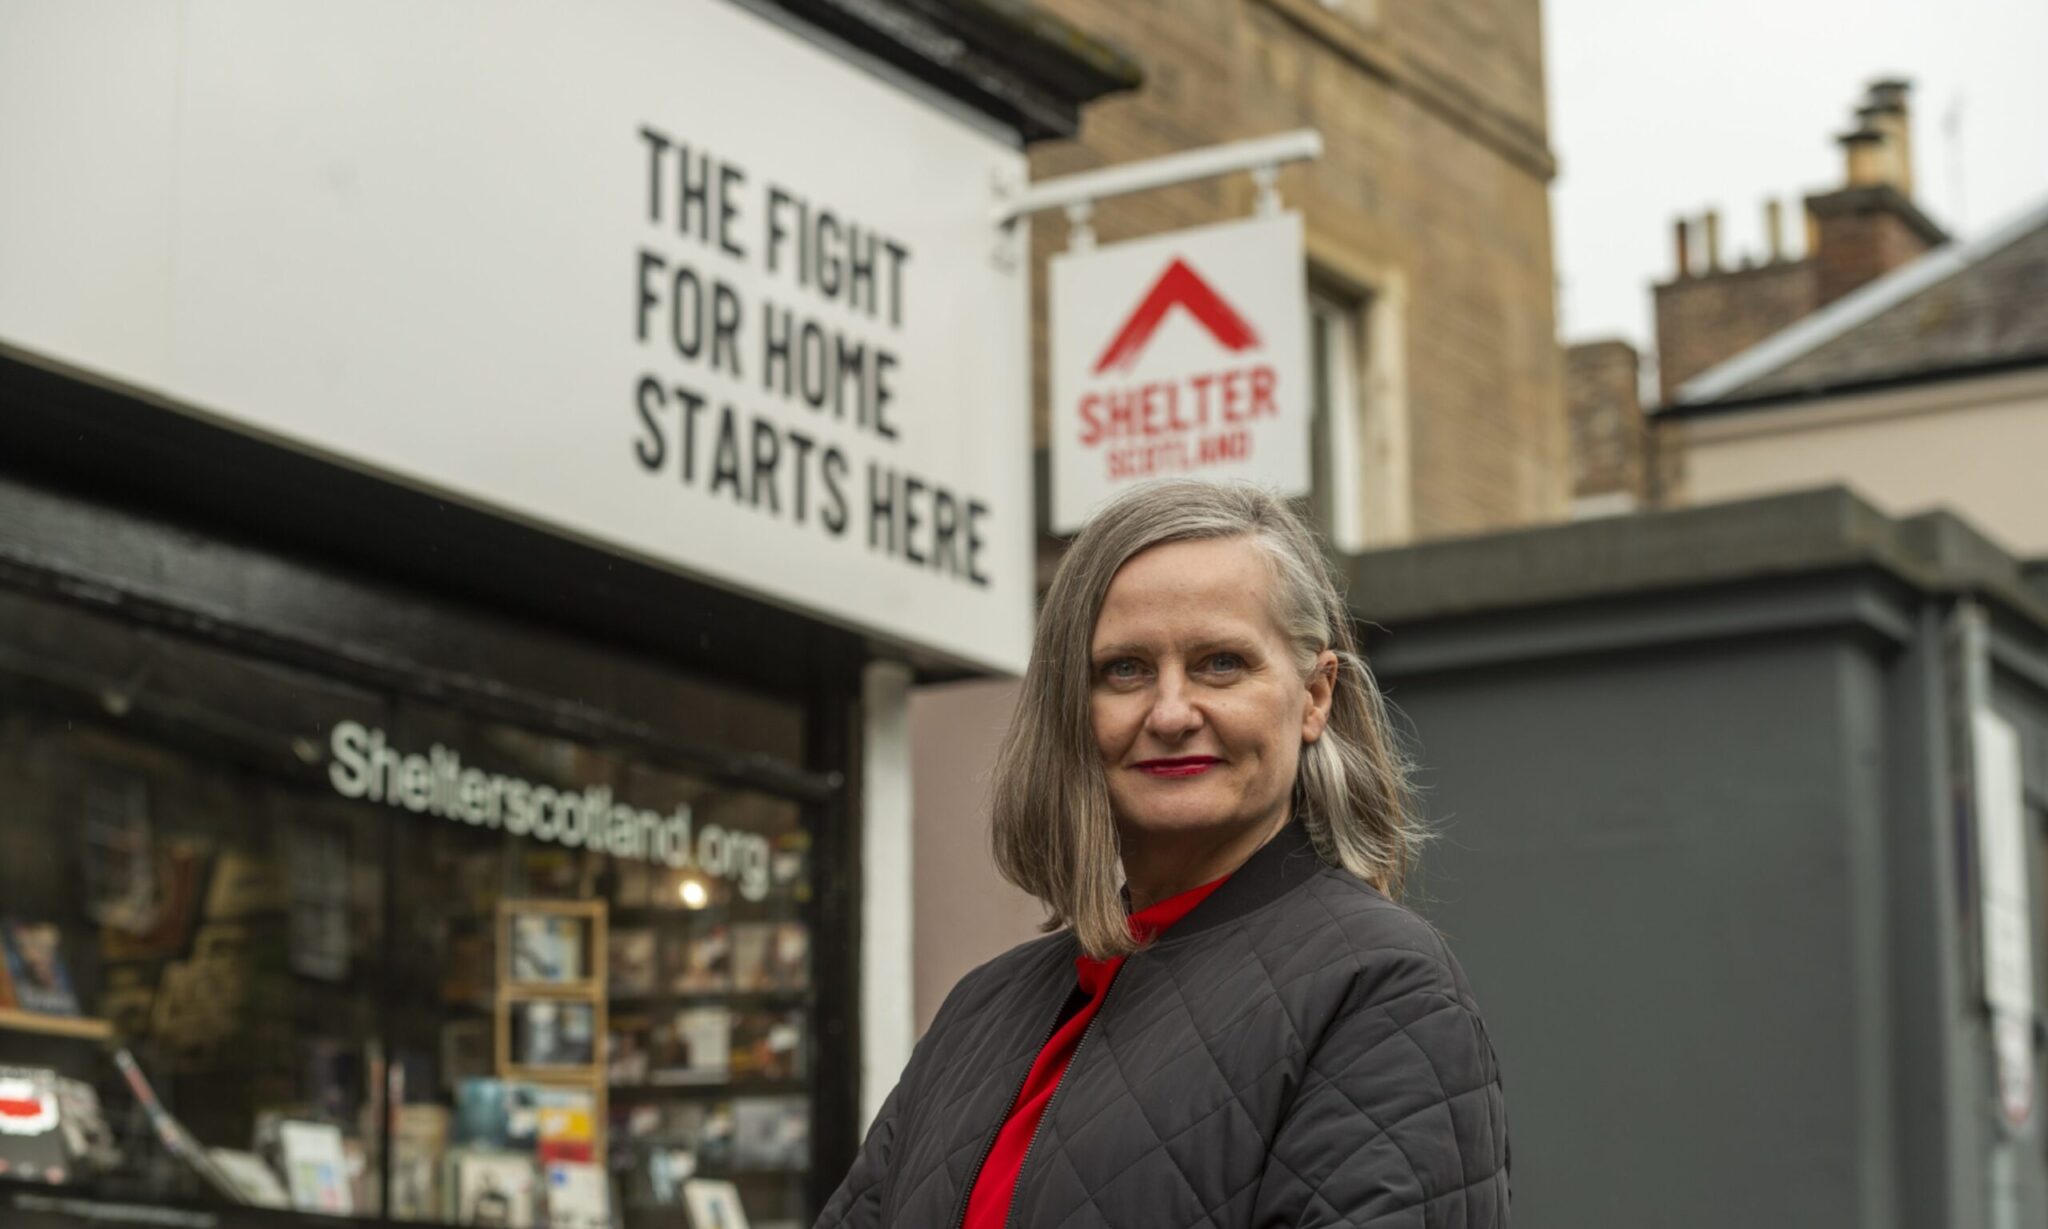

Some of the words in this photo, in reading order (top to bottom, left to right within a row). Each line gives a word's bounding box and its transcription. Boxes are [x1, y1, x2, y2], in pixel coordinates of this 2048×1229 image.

[639, 124, 746, 260] THE
[767, 184, 911, 329] FIGHT
[636, 248, 741, 380] FOR
[764, 301, 901, 442] HOME
[1078, 365, 1279, 446] SHELTER
[634, 375, 849, 536] STARTS
[868, 460, 991, 588] HERE
[1105, 430, 1252, 482] SCOTLAND
